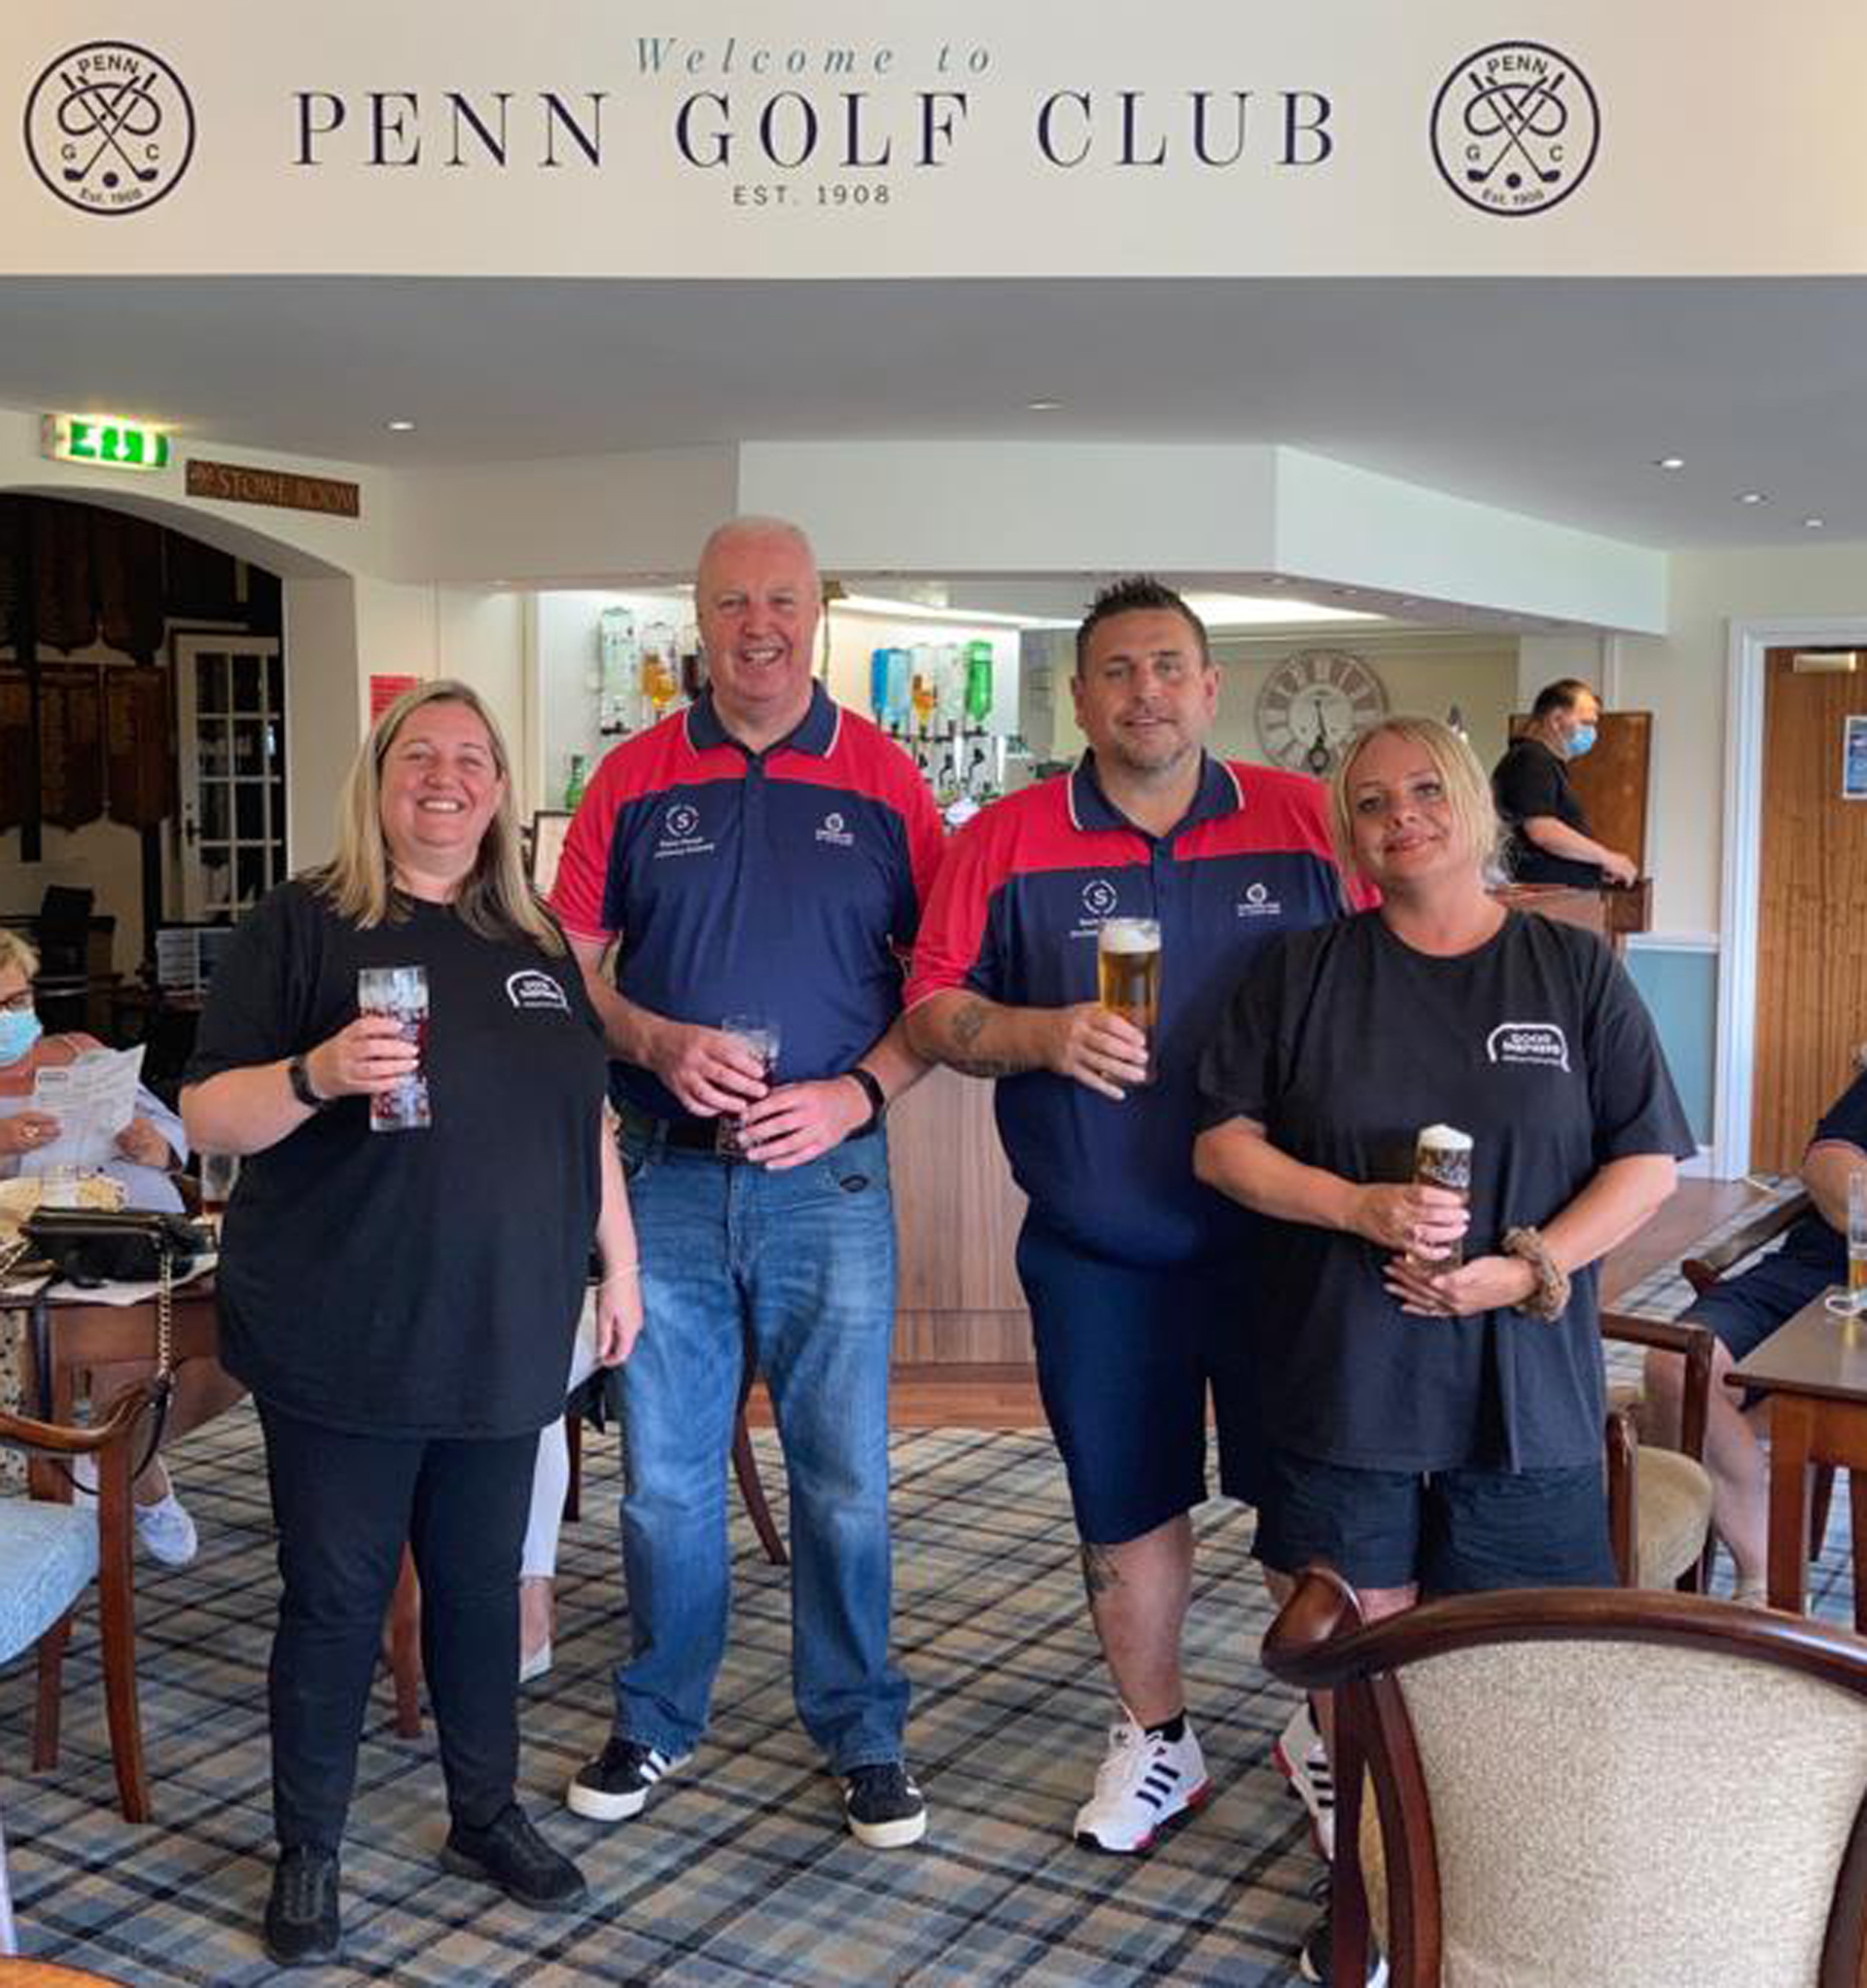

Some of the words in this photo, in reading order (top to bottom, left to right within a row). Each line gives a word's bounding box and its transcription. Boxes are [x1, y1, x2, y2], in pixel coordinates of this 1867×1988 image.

[77, 54, 140, 74] PENN
[635, 37, 894, 75] Welcome
[937, 44, 990, 73] to
[1486, 54, 1549, 75] PENN
[292, 91, 609, 167] PENN
[676, 89, 967, 169] GOLF
[1038, 89, 1333, 168] CLUB
[60, 143, 77, 161] G
[145, 143, 160, 161] C
[1465, 144, 1481, 161] G
[1548, 144, 1564, 162] C
[732, 185, 798, 205] EST.
[817, 185, 890, 205] 1908
[1093, 887, 1109, 906] S
